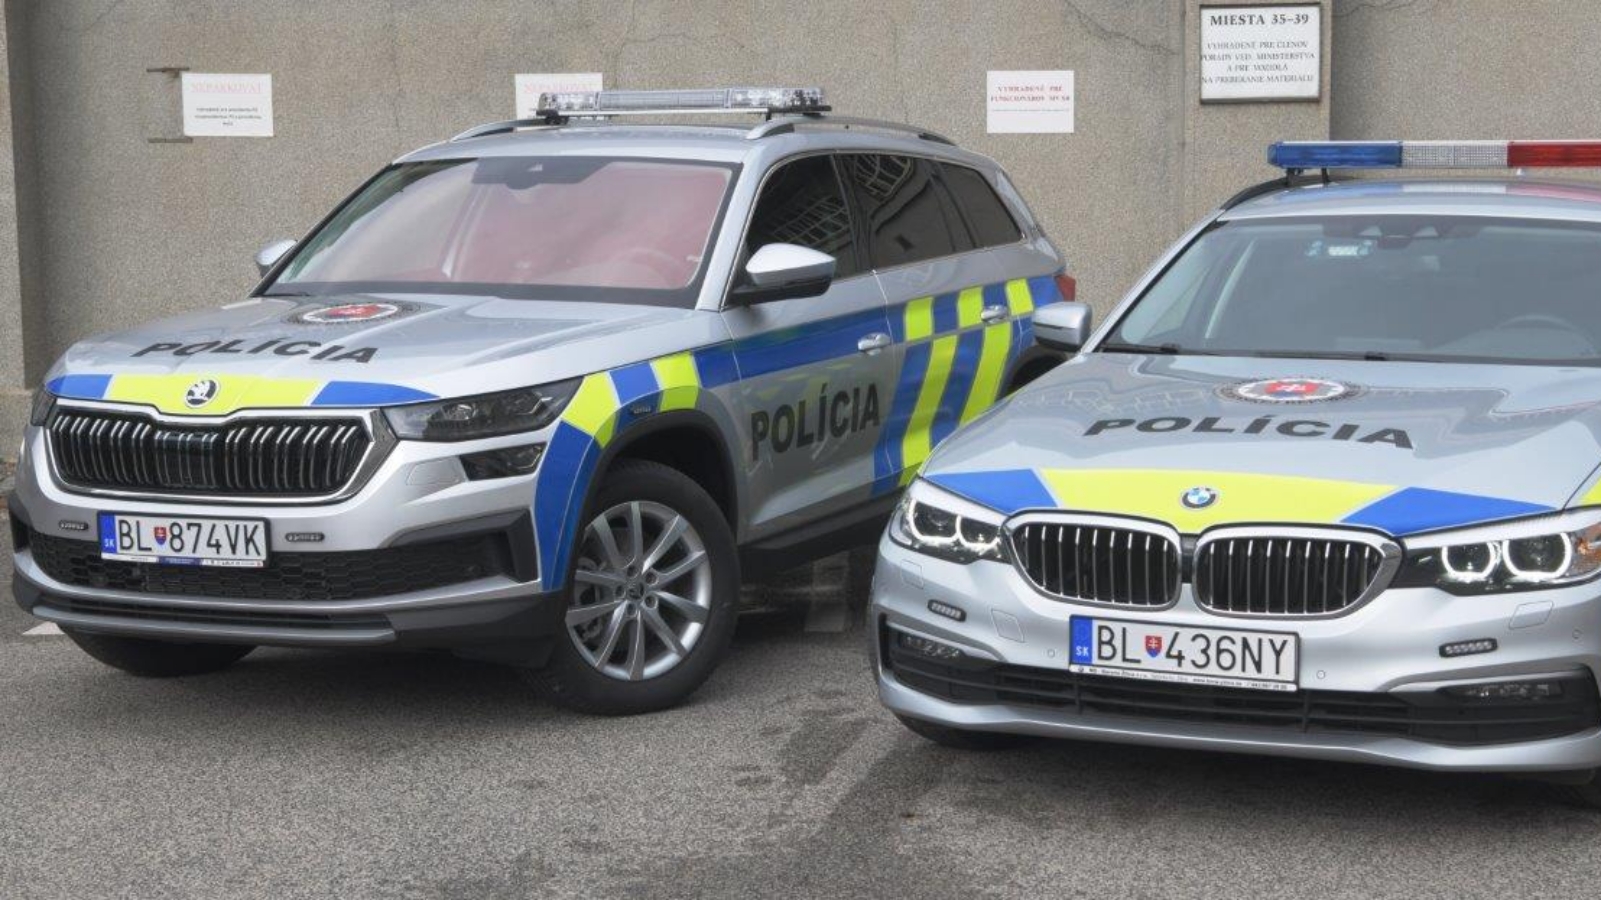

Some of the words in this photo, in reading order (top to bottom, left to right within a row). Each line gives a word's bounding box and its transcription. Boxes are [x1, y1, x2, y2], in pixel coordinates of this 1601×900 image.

[1210, 14, 1265, 26] MIESTA
[1271, 13, 1309, 25] 35-39
[130, 336, 378, 364] POLÍCIA
[751, 382, 881, 462] POLÍCIA
[1083, 414, 1414, 450] POLÍCIA
[104, 538, 115, 549] SK
[1075, 645, 1090, 657] SK
